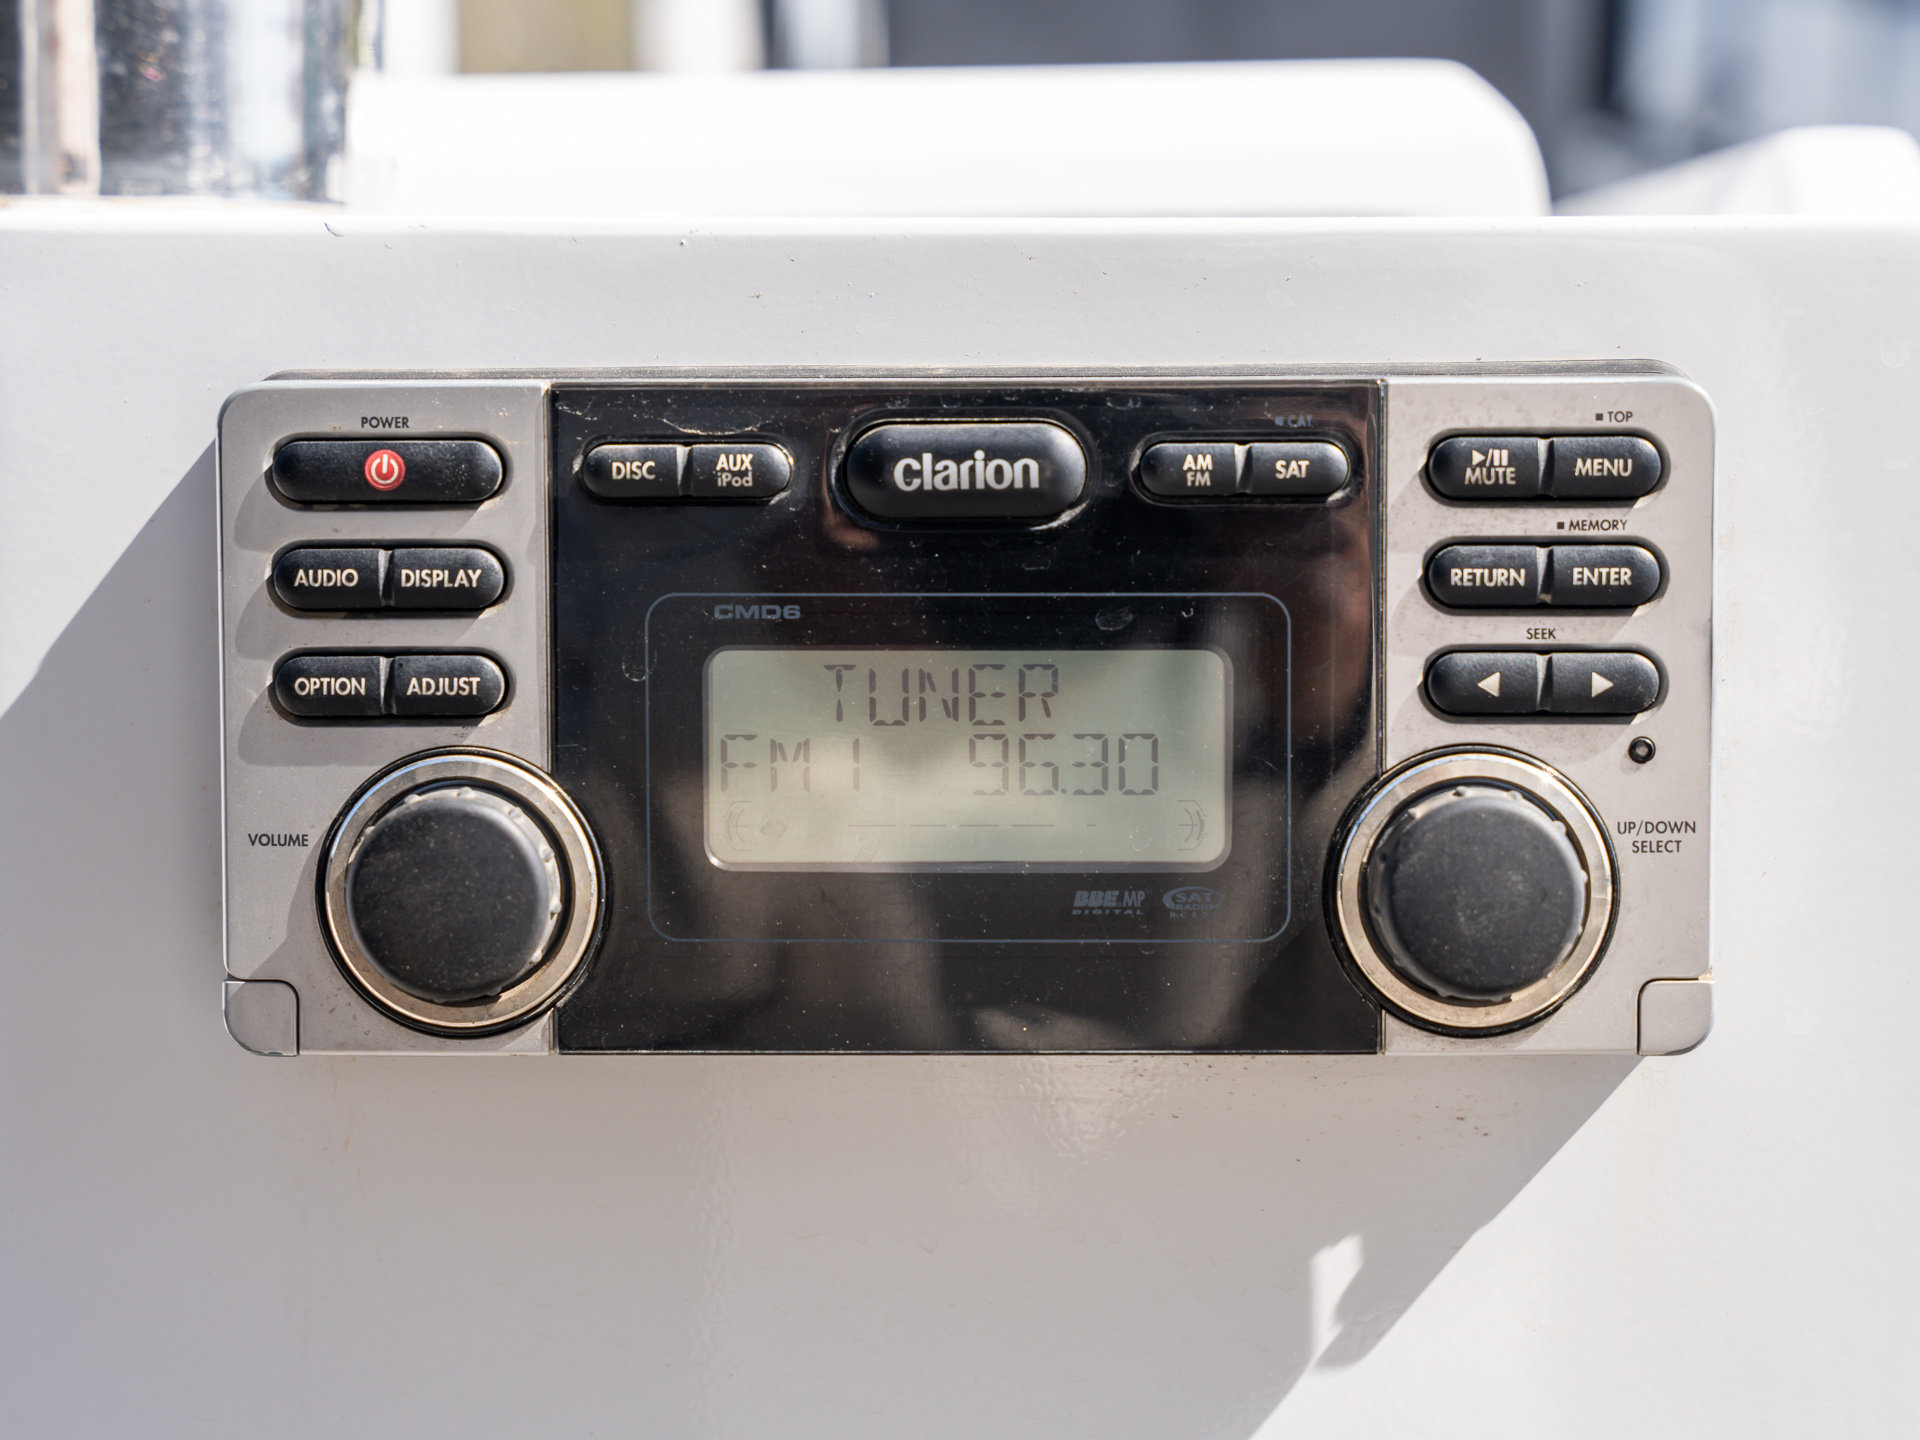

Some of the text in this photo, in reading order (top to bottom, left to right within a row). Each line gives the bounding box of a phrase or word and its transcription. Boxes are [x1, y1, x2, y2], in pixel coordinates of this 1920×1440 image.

[360, 416, 410, 429] POWER
[1607, 411, 1634, 423] TOP
[611, 461, 656, 480] DISC
[715, 454, 753, 471] AUX
[893, 449, 1040, 492] clarion
[1182, 453, 1213, 471] AM
[1275, 459, 1310, 479] SAT
[1574, 458, 1633, 477] MENU
[717, 471, 753, 487] iPod
[1186, 471, 1211, 487] FM
[1464, 467, 1516, 485] MUTE
[1568, 519, 1627, 531] MEMORY
[294, 568, 358, 587] AUDIO
[400, 568, 482, 588] DISPLAY
[1450, 568, 1526, 587] RETURN
[1572, 567, 1632, 586] ENTER
[714, 604, 800, 620] CMD6
[1526, 628, 1556, 640] SEEK
[294, 677, 366, 696] OPTION
[406, 677, 480, 696] ADJUST
[823, 664, 1059, 726] TUNER
[968, 733, 1159, 796] 96.30
[1617, 820, 1696, 836] UP/DOWN
[248, 833, 309, 847] VOLUME
[1632, 840, 1682, 854] SELECT
[1175, 892, 1215, 903] SAT
